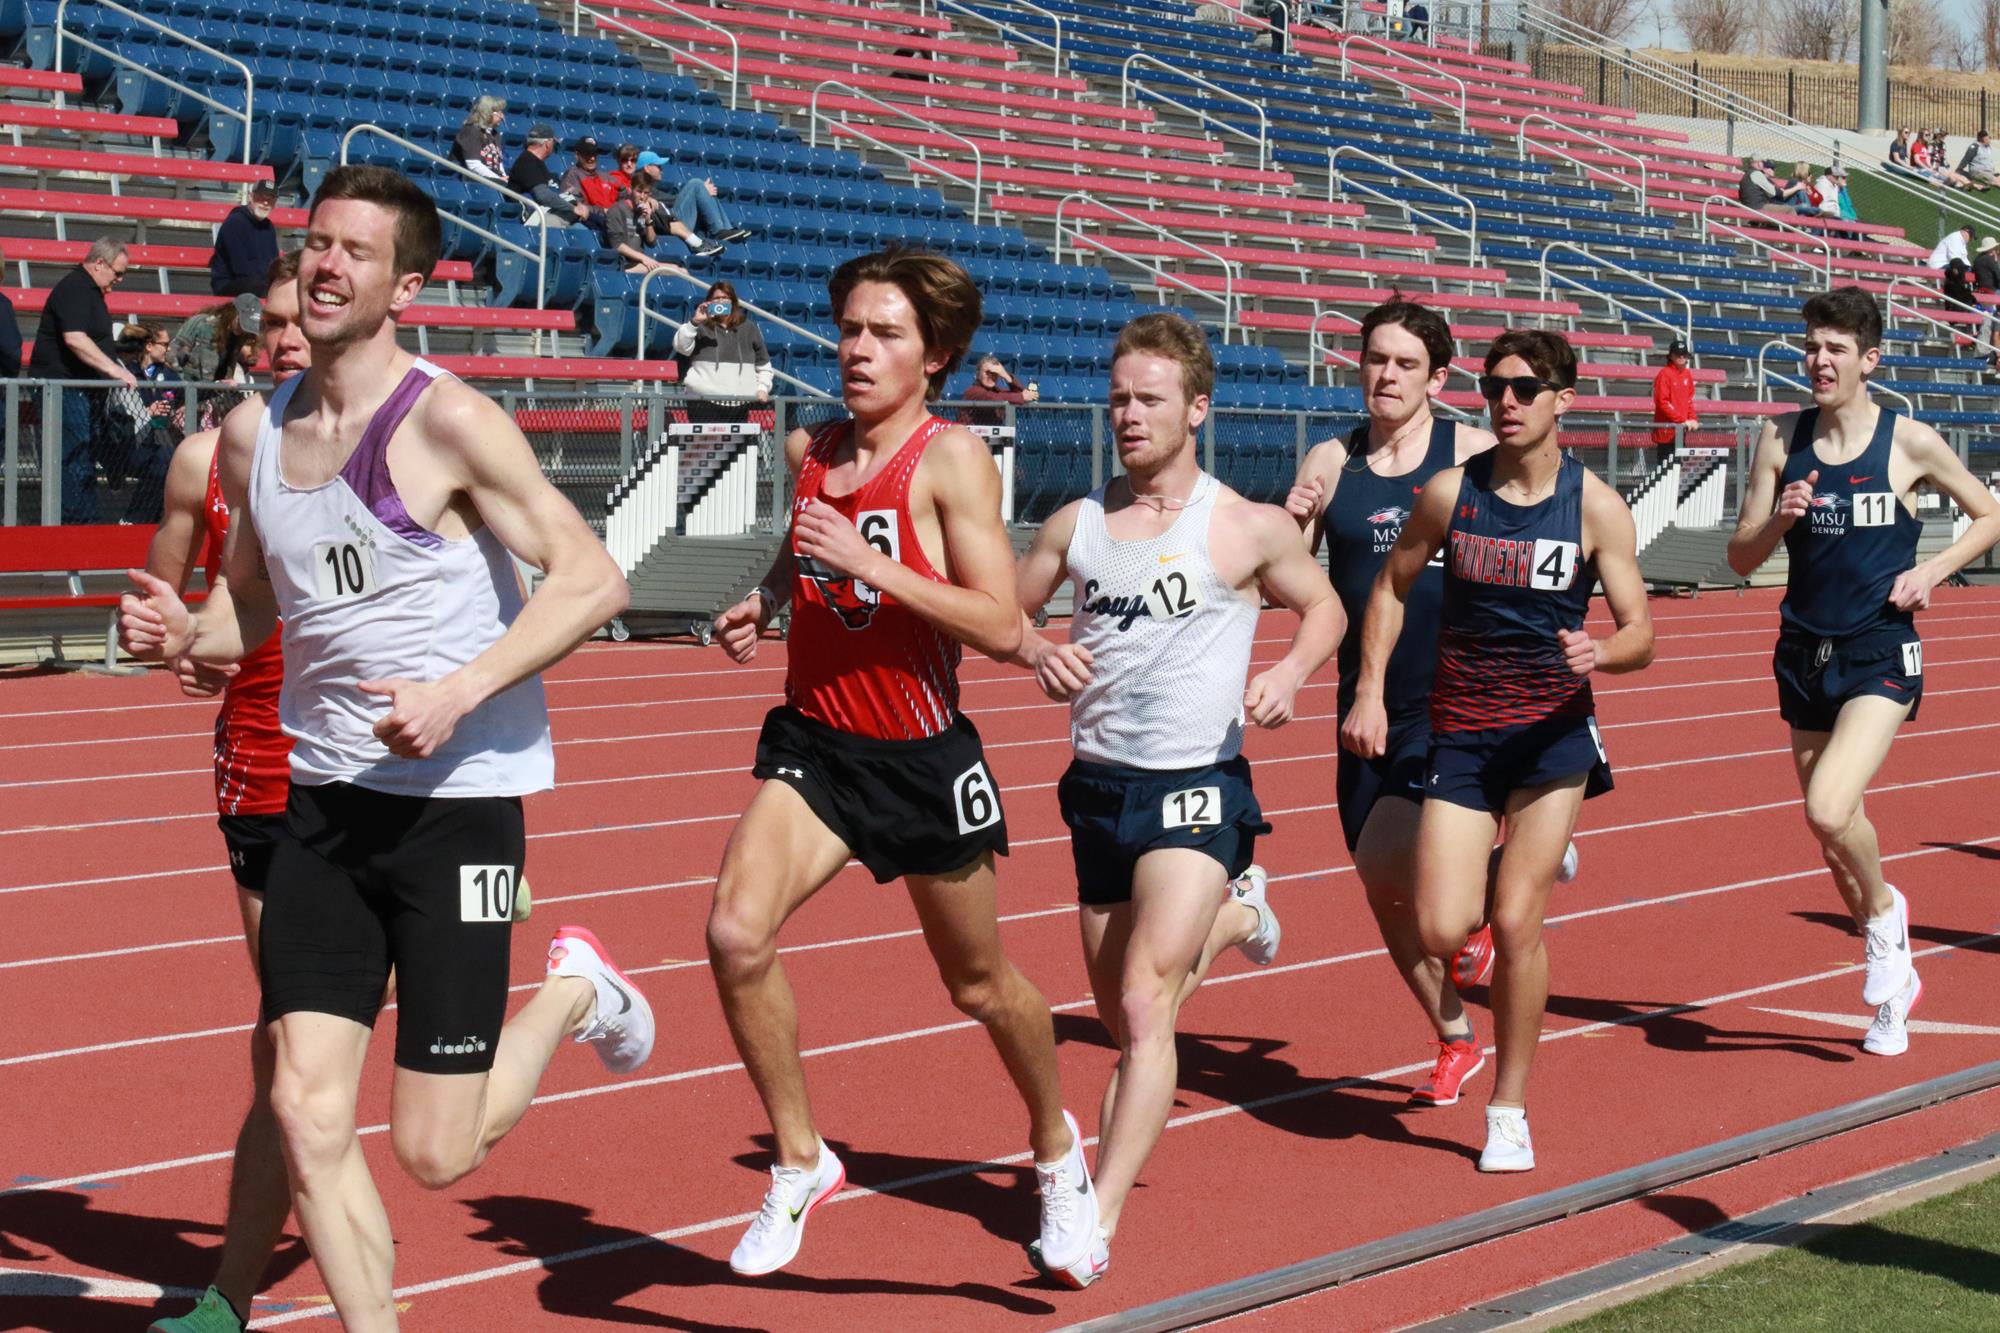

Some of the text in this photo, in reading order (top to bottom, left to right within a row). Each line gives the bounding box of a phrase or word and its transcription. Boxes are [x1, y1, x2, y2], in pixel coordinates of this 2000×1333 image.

[1811, 512, 1845, 525] MSU
[1861, 495, 1886, 524] 11
[860, 514, 892, 558] 6
[1373, 527, 1402, 542] MS
[1373, 544, 1393, 553] DEN
[1811, 527, 1845, 535] DENVER
[325, 544, 364, 595] 10
[1451, 530, 1580, 588] THUNDERW
[1536, 545, 1565, 587] 4
[1152, 571, 1197, 615] 12
[961, 772, 992, 827] 6
[1173, 790, 1211, 823] 12
[473, 868, 510, 919] 10
[430, 1035, 487, 1054] diadora
